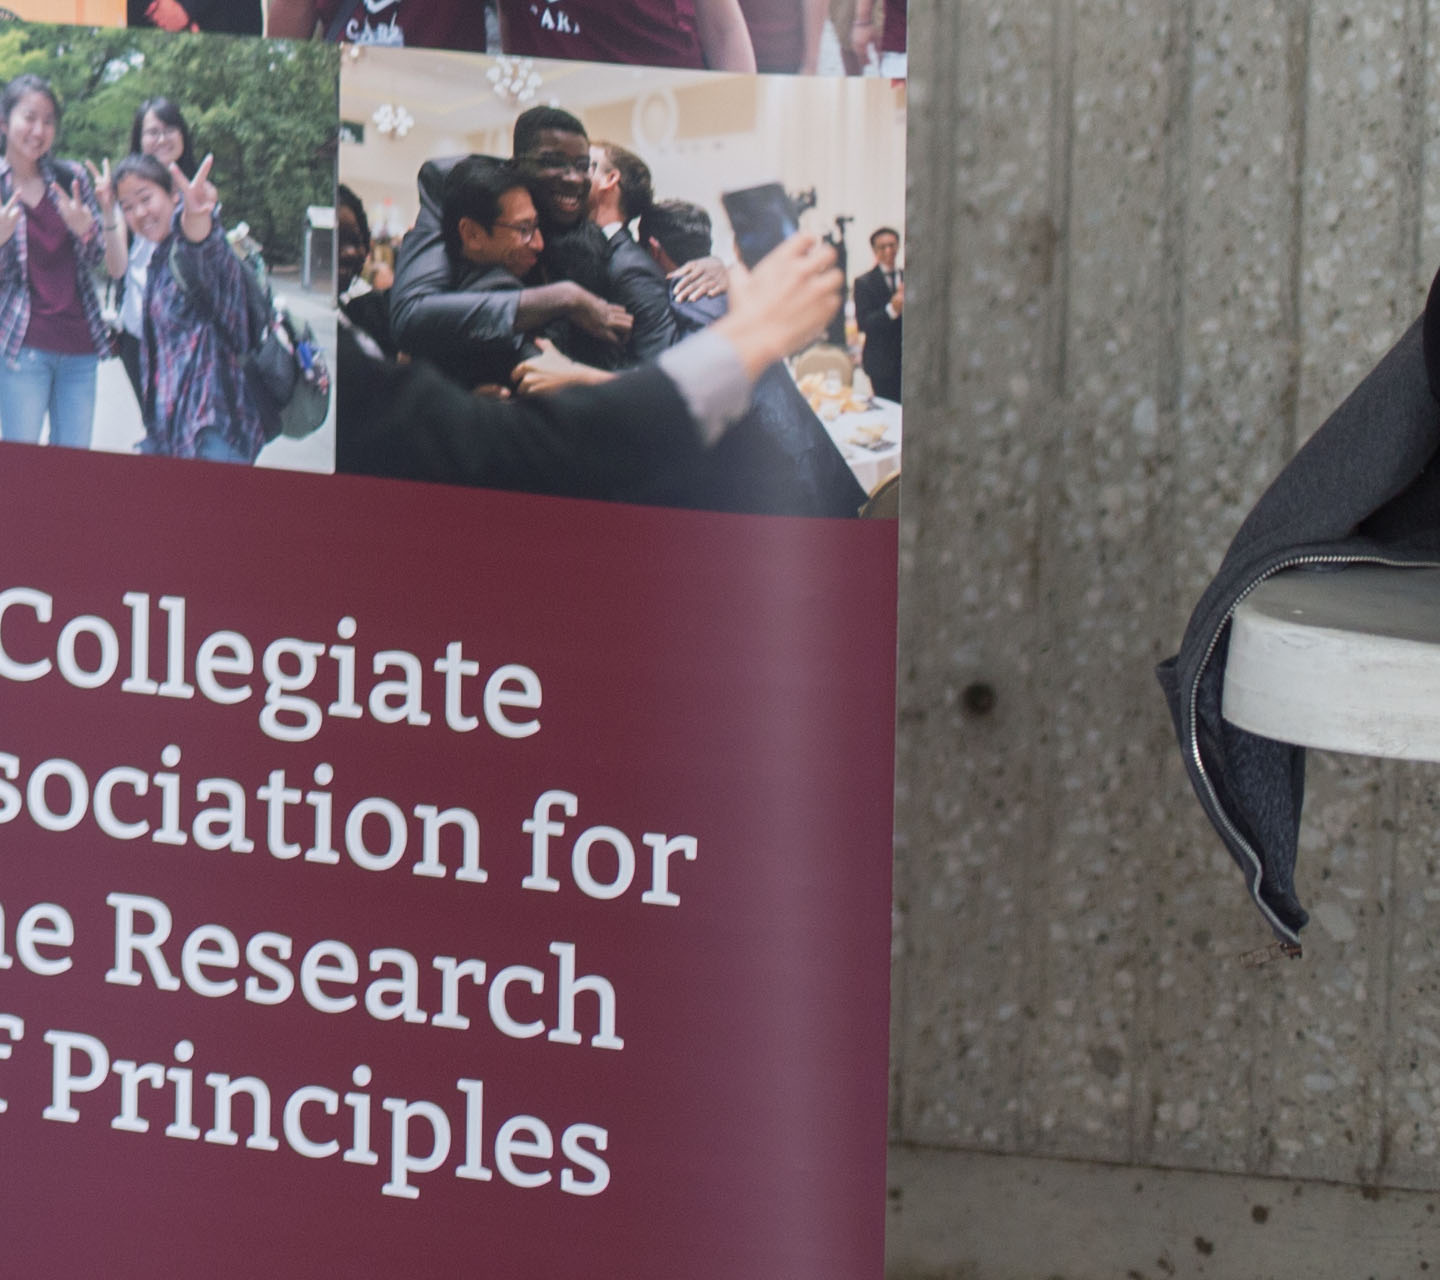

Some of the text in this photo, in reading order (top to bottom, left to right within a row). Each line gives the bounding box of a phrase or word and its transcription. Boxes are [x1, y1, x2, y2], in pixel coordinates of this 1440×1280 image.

[522, 790, 699, 907] for
[104, 890, 626, 1050] Research
[43, 1028, 612, 1200] Principles
